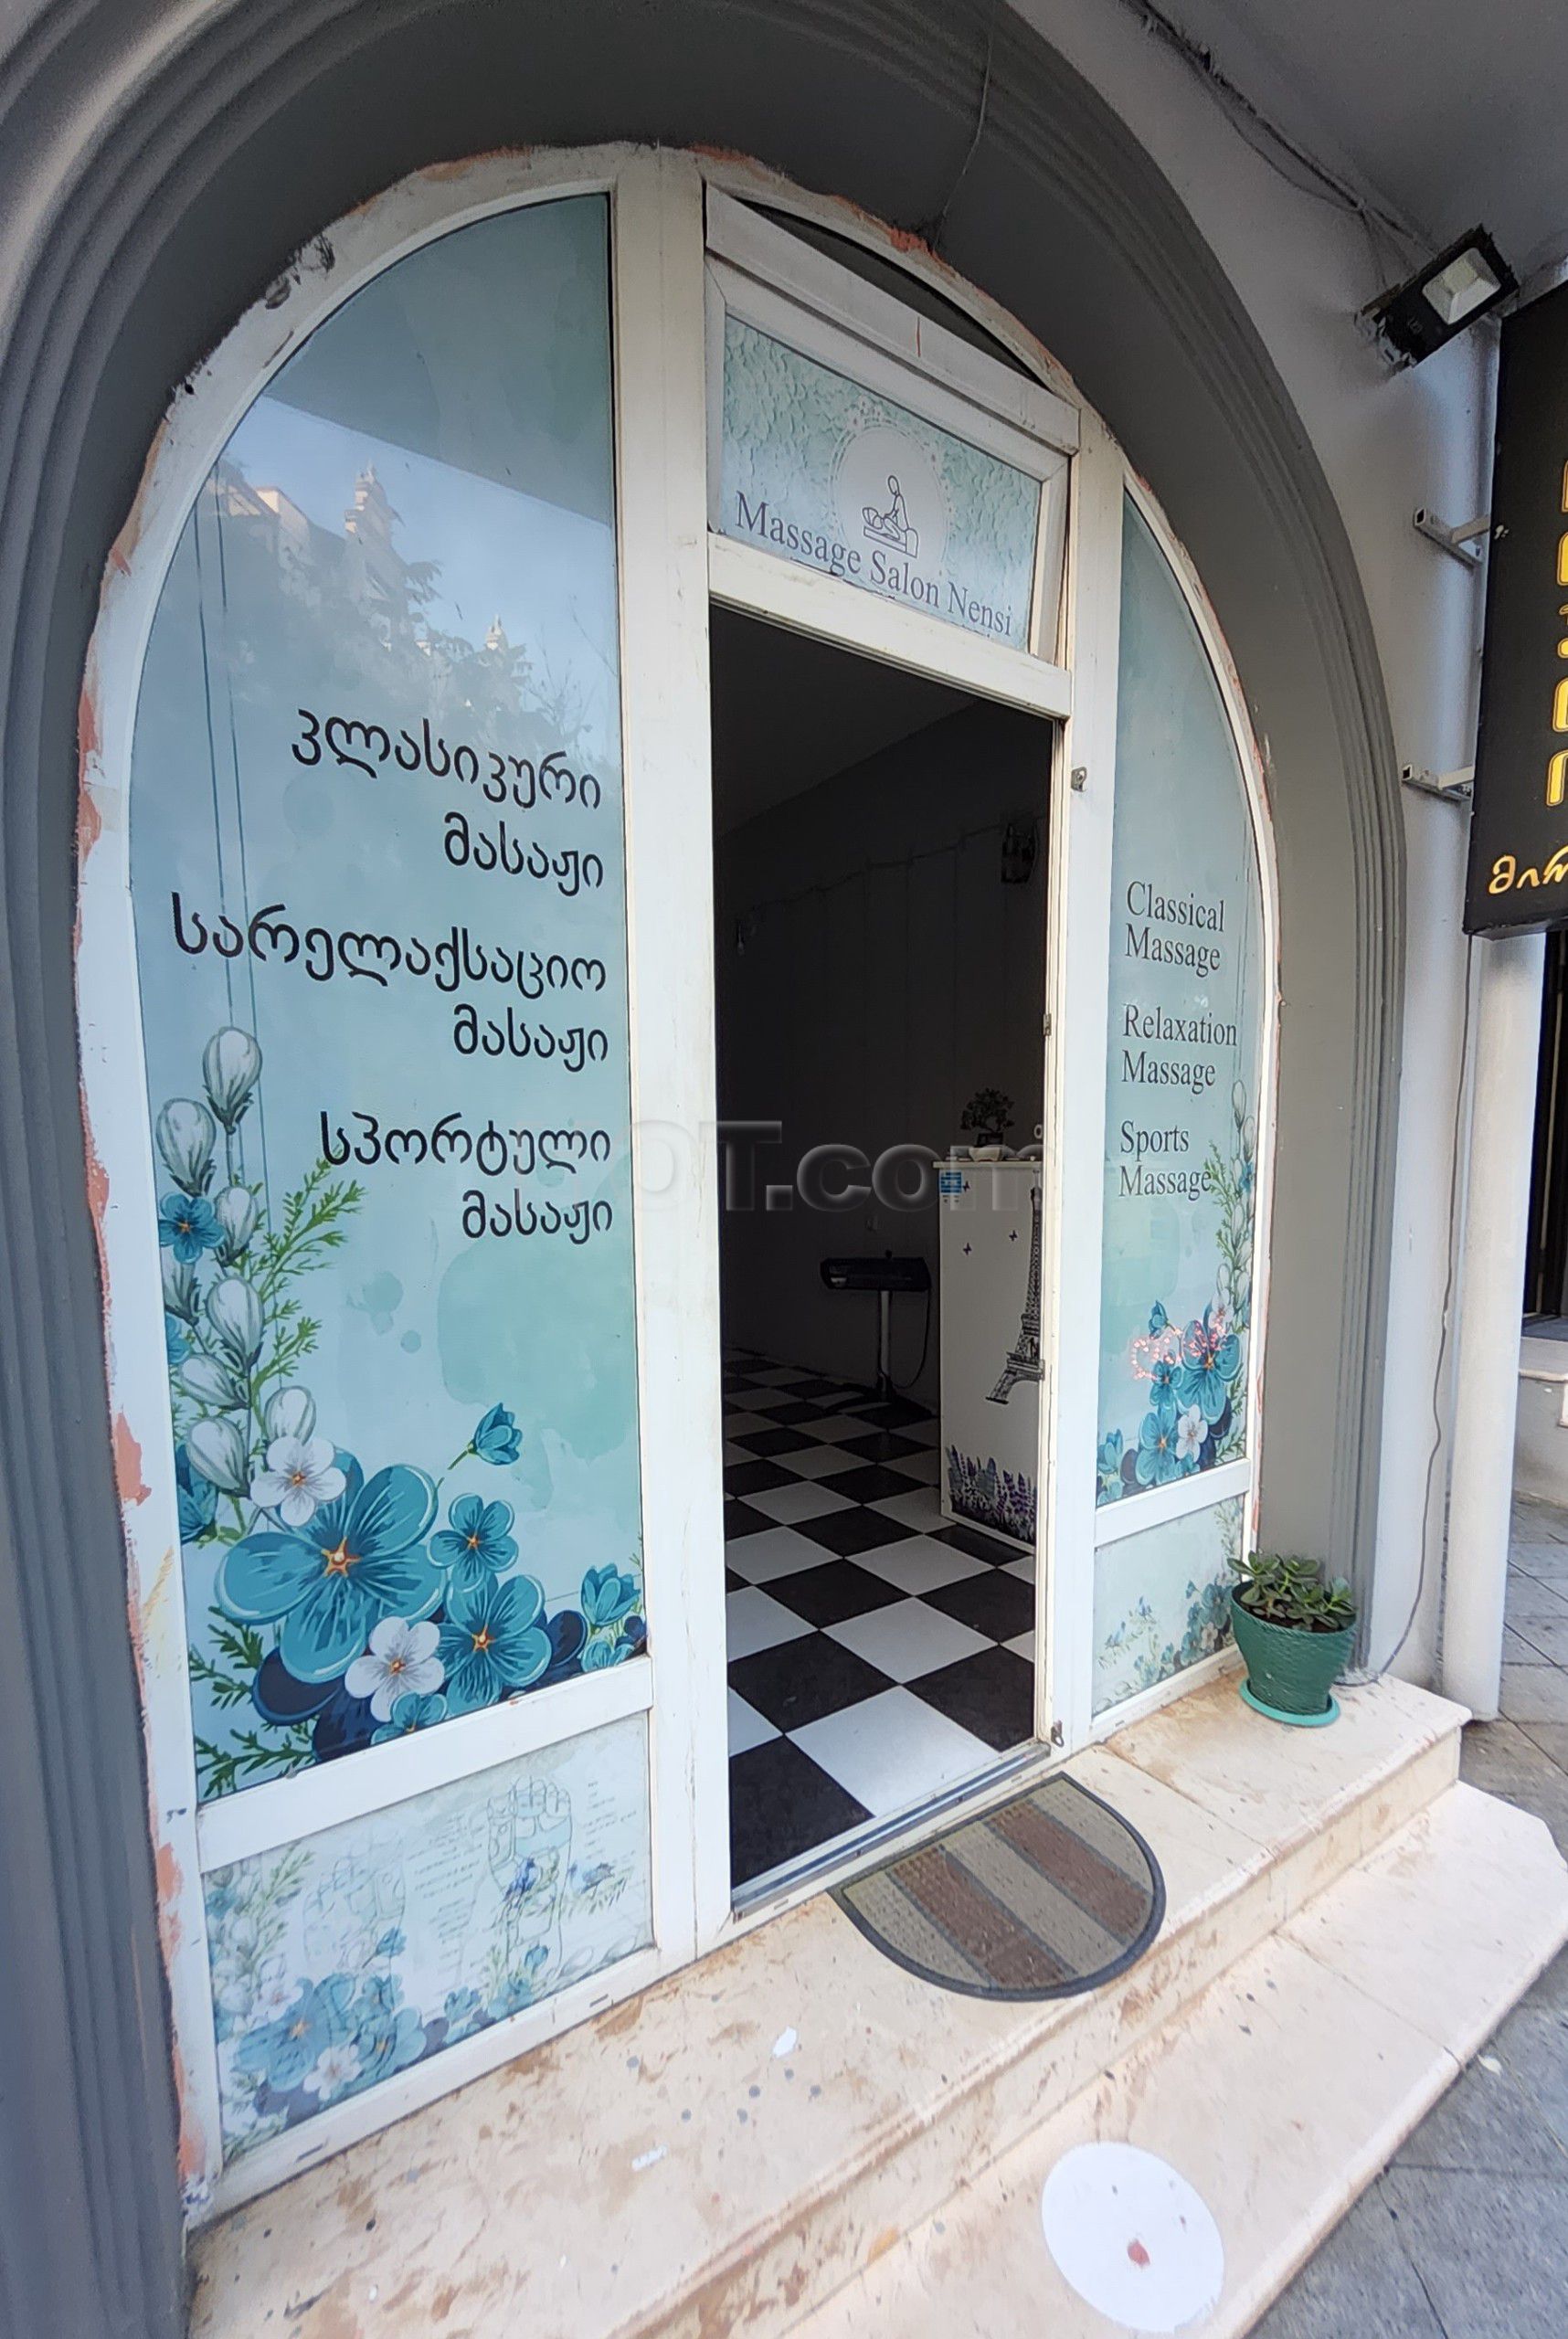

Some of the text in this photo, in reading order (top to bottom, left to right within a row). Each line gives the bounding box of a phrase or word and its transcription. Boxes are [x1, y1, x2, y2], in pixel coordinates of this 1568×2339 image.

[735, 490, 1012, 637] Massage Salon Nensi
[291, 708, 601, 810] კლასიკური
[444, 811, 604, 896] მასაჟი
[1126, 881, 1225, 932] Classical
[171, 891, 607, 1000] სარელაქსაციო
[1124, 922, 1222, 978] Massage
[453, 1003, 609, 1073] მასაჟი
[1122, 1003, 1238, 1047] Relaxation
[1121, 1049, 1216, 1095] Massage
[320, 1110, 611, 1177] სპორტული
[1119, 1119, 1191, 1162] Sports
[1118, 1164, 1213, 1202] Massage
[461, 1188, 613, 1245] მასაჟი
